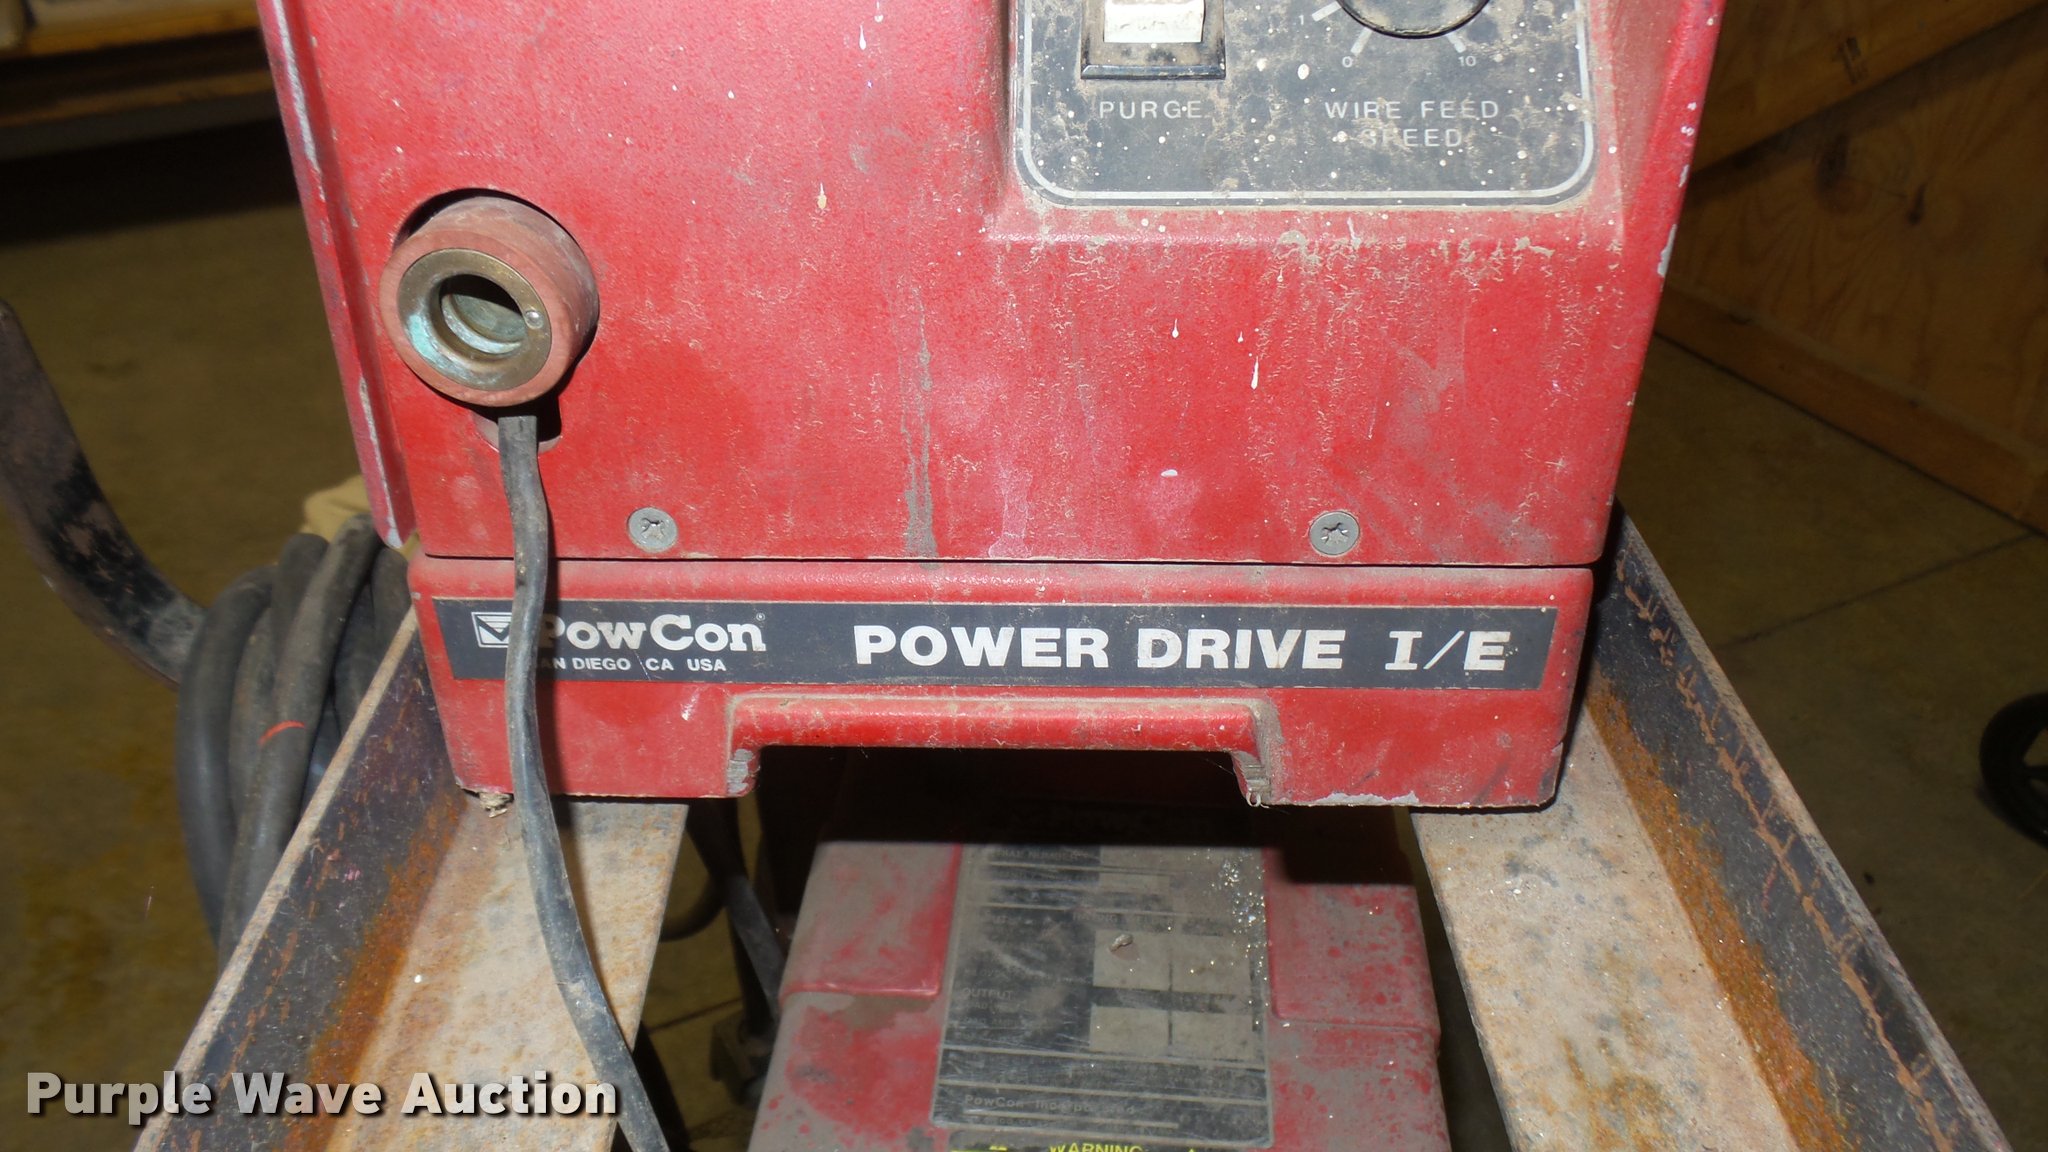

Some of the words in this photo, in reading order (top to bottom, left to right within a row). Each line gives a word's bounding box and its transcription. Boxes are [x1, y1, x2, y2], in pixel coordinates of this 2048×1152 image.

[1458, 55, 1477, 67] 10
[1100, 101, 1202, 119] PURGE
[1325, 100, 1401, 119] WIRE
[1421, 100, 1499, 118] FEED
[1361, 128, 1462, 147] SPEED
[853, 625, 1110, 669] POWER
[1136, 628, 1344, 670] DRIVE
[1384, 630, 1512, 671] I/E
[572, 657, 631, 671] DIEGO
[645, 657, 674, 671] CA
[687, 658, 727, 672] USA
